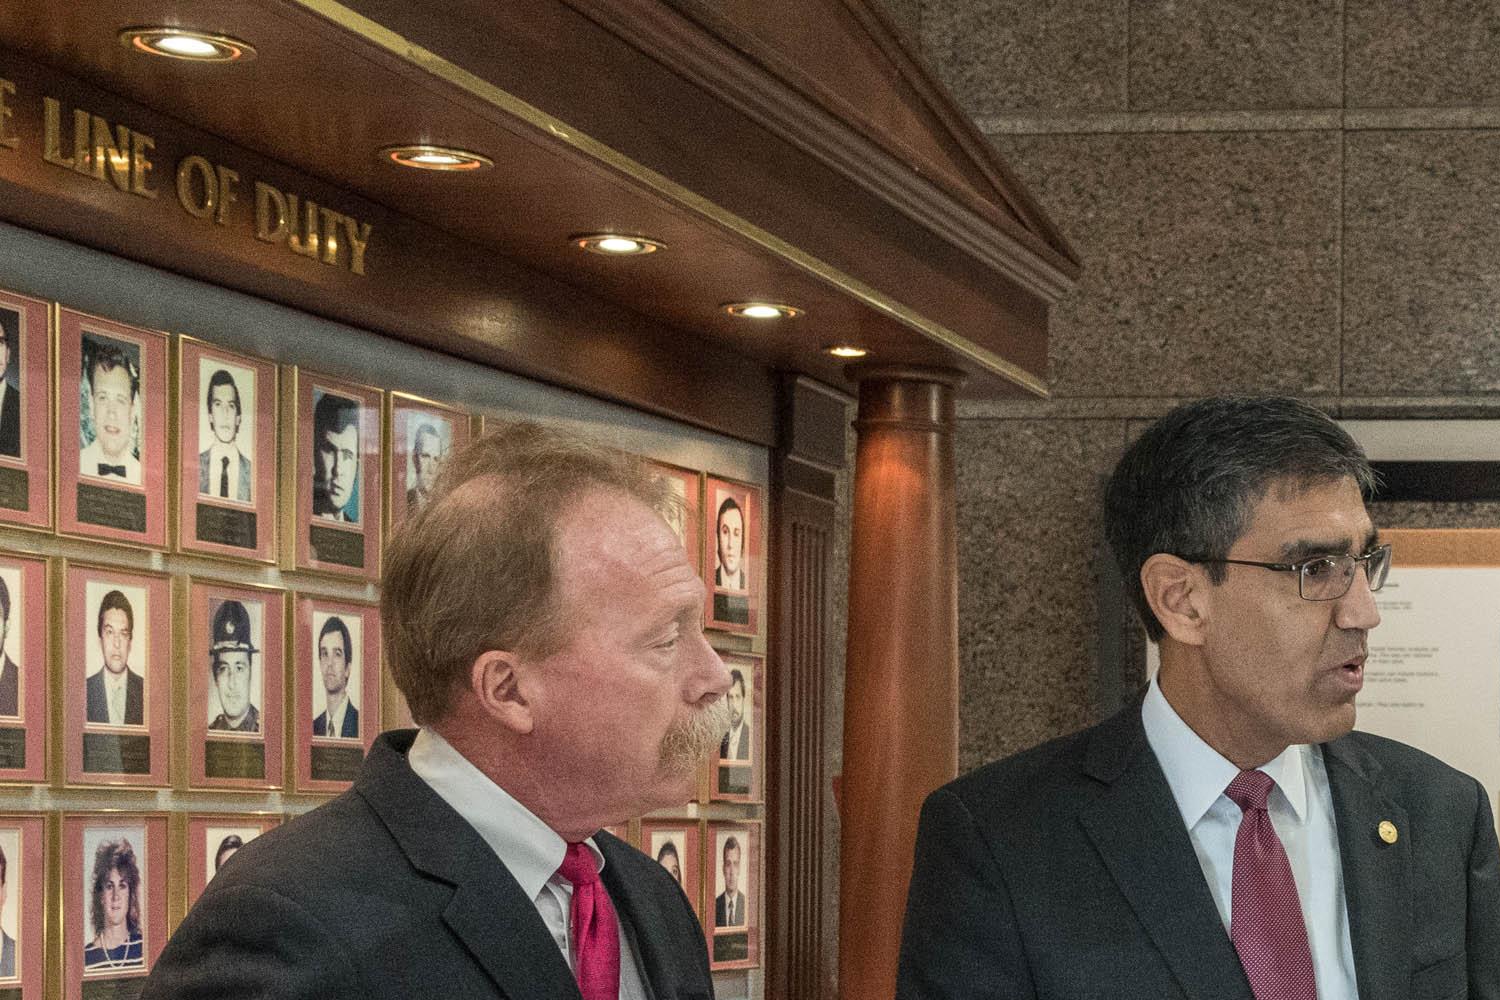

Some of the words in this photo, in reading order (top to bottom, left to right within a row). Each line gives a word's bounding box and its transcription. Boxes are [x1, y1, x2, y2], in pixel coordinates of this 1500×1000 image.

[43, 96, 158, 199] LINE
[177, 155, 239, 224] OF
[255, 181, 372, 276] DUTY
